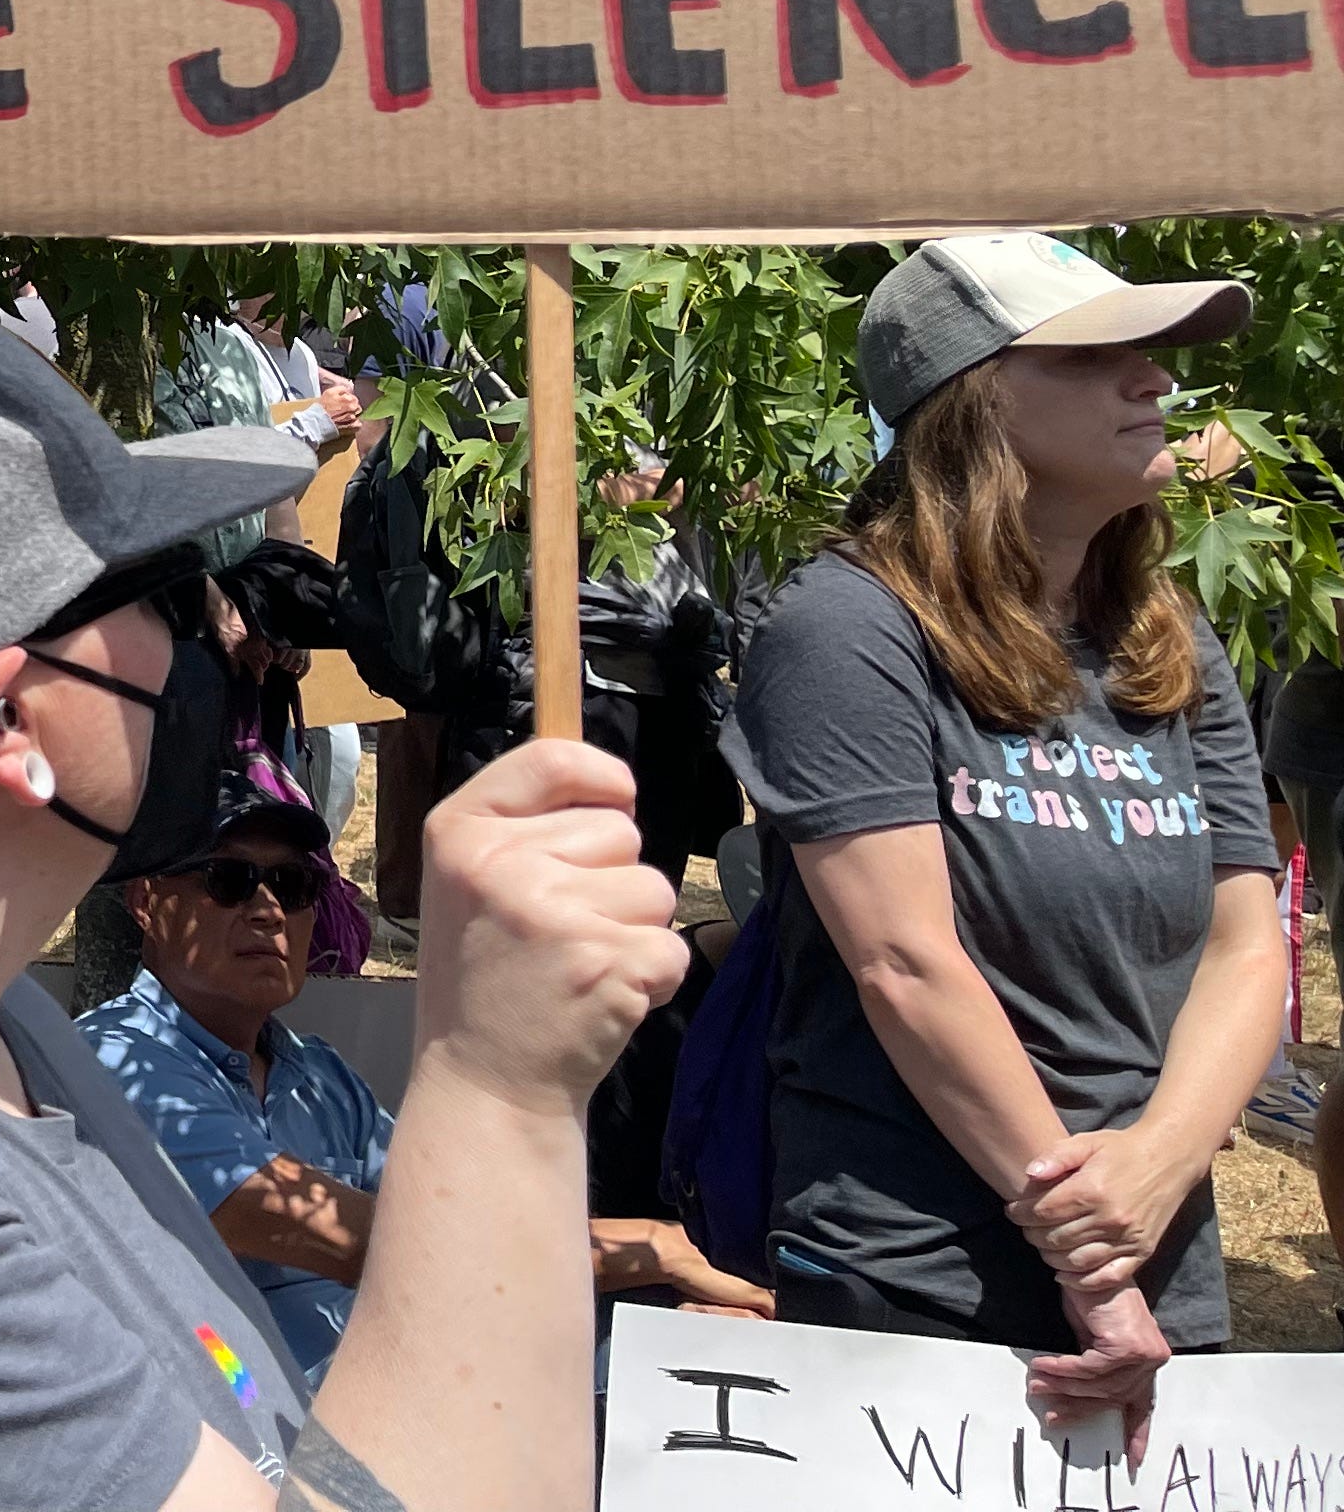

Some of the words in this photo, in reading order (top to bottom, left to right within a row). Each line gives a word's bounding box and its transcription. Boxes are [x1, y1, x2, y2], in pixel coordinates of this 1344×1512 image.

[949, 766, 1089, 832] trans
[1100, 782, 1210, 846] yout
[657, 1366, 799, 1462] I
[860, 1403, 1140, 1512] WILL
[1160, 1442, 1344, 1512] ALWAY
